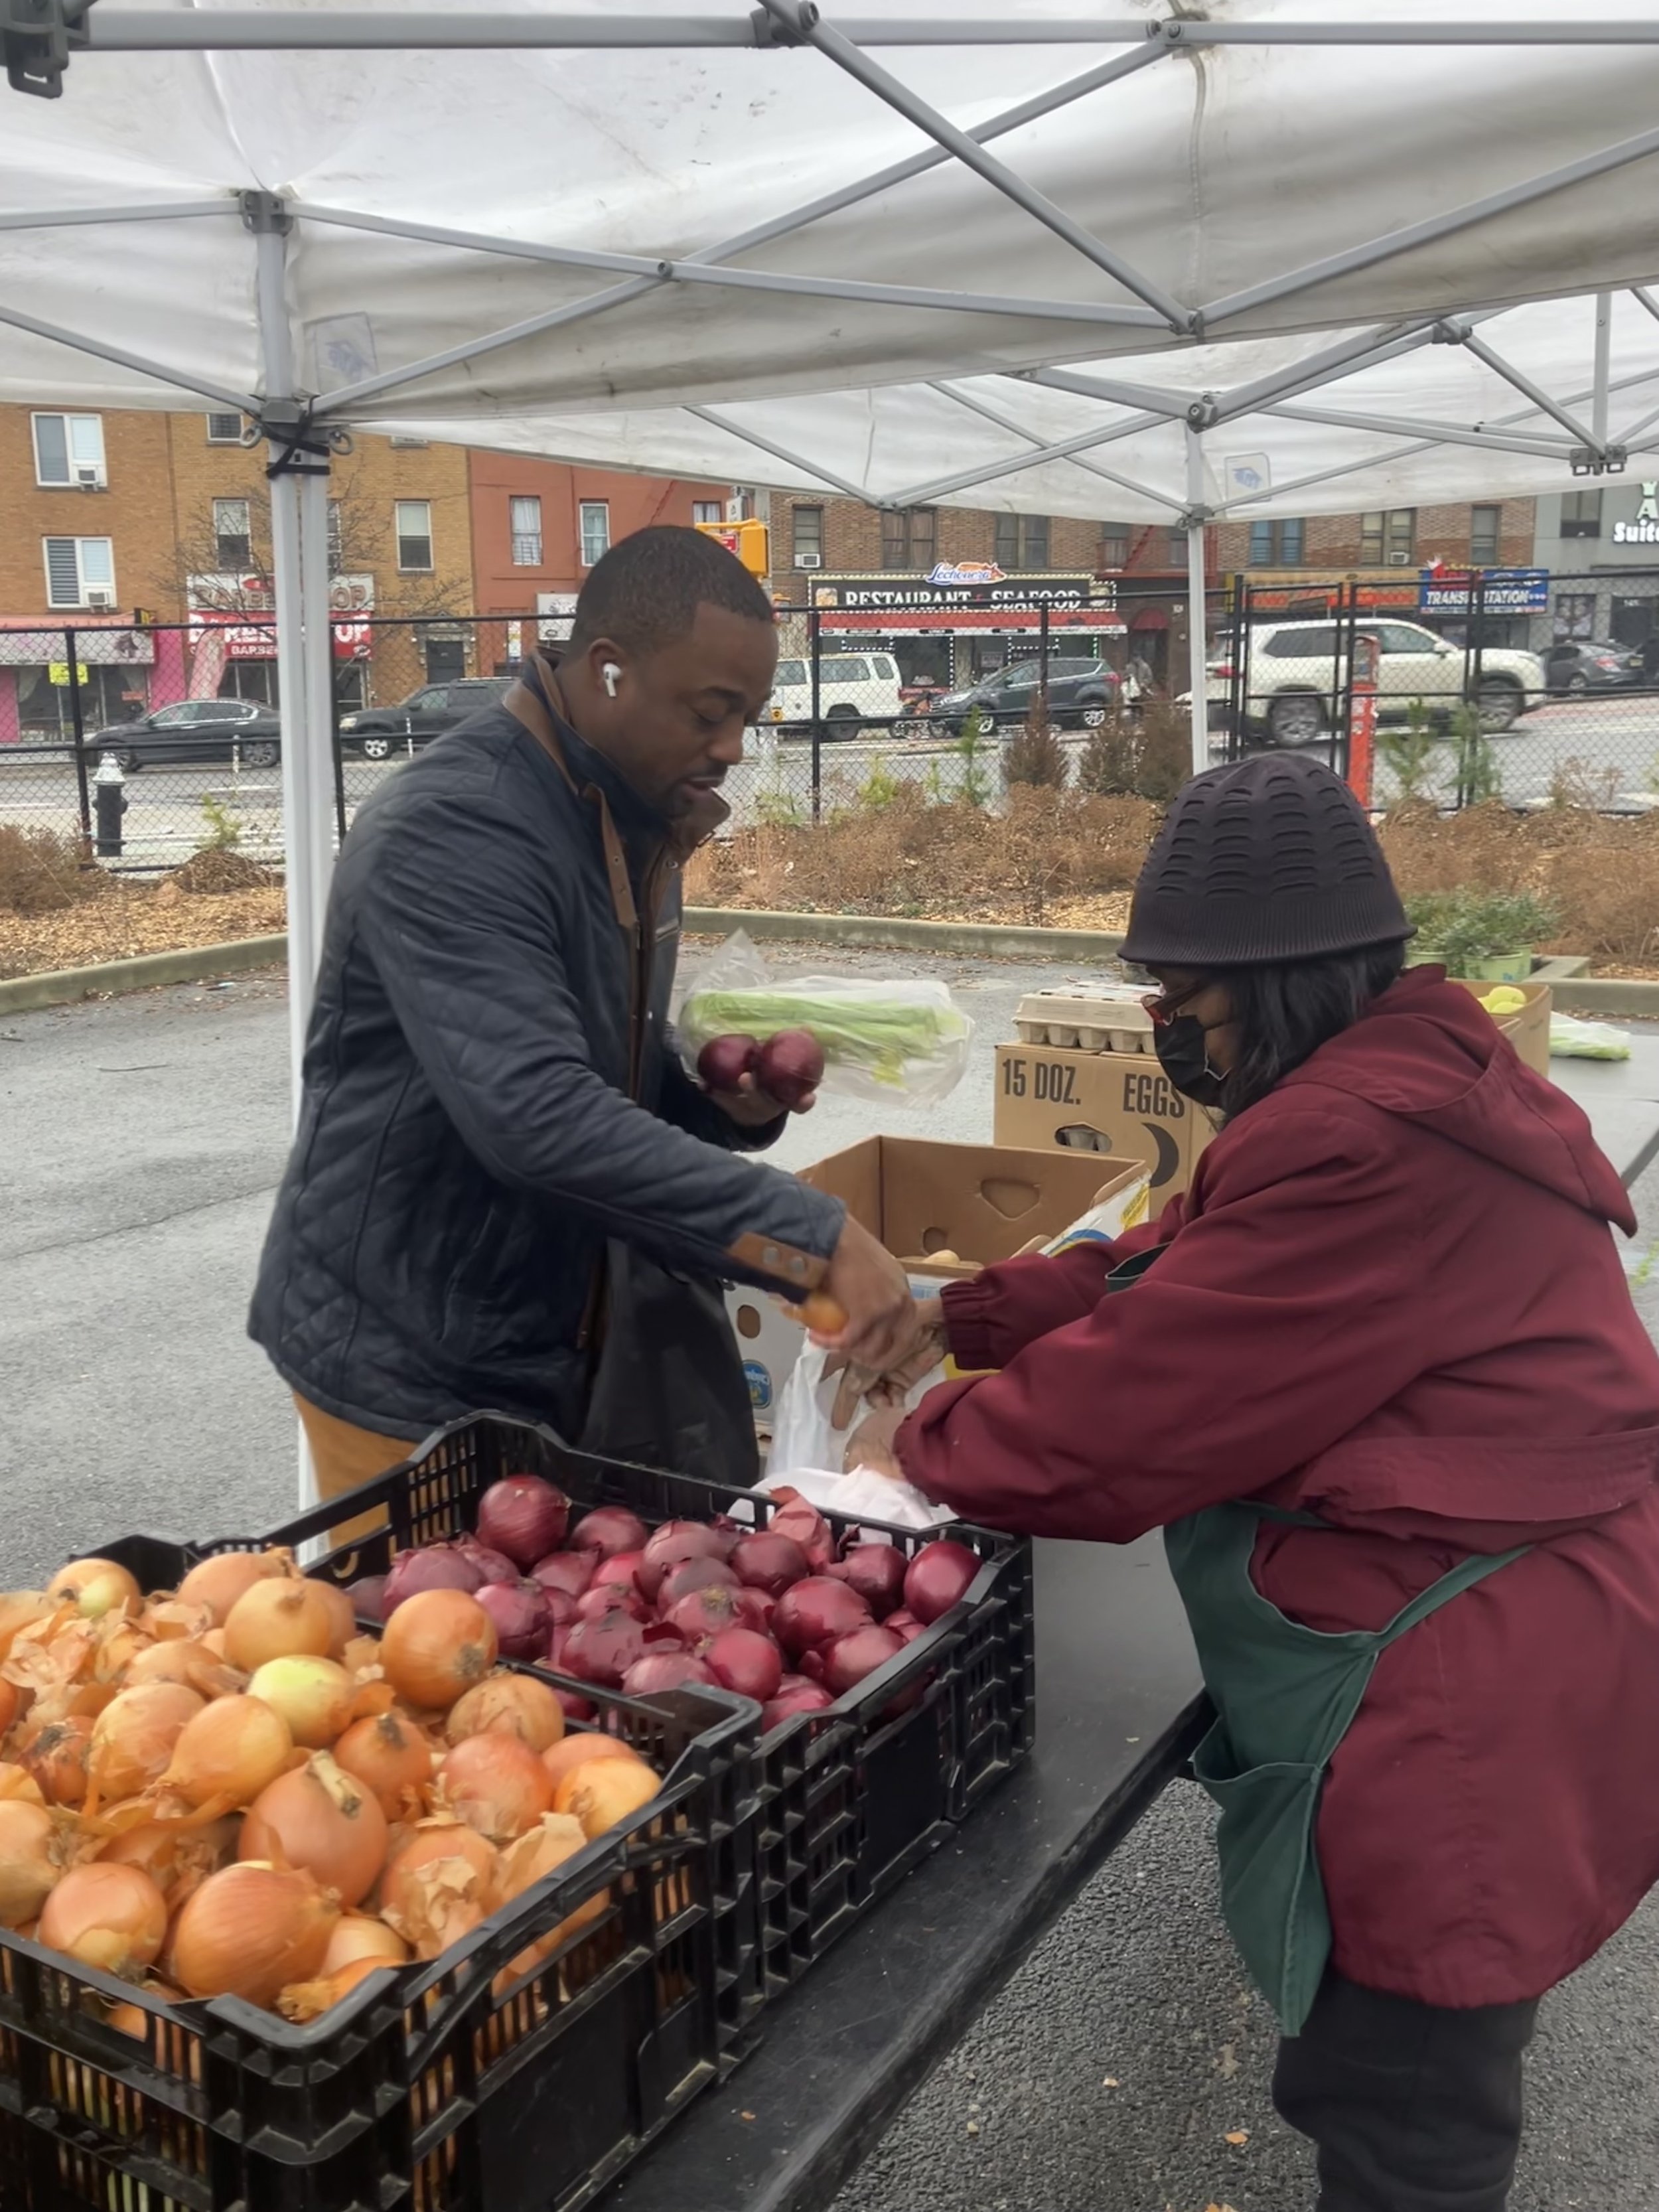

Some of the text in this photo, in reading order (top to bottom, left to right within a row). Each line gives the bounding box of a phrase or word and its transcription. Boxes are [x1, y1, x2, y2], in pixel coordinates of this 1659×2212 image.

[990, 590, 1082, 610] SEAFOOD
[232, 644, 277, 656] BARBE
[1003, 1059, 1185, 1119] 15 DOZ. EGGS
